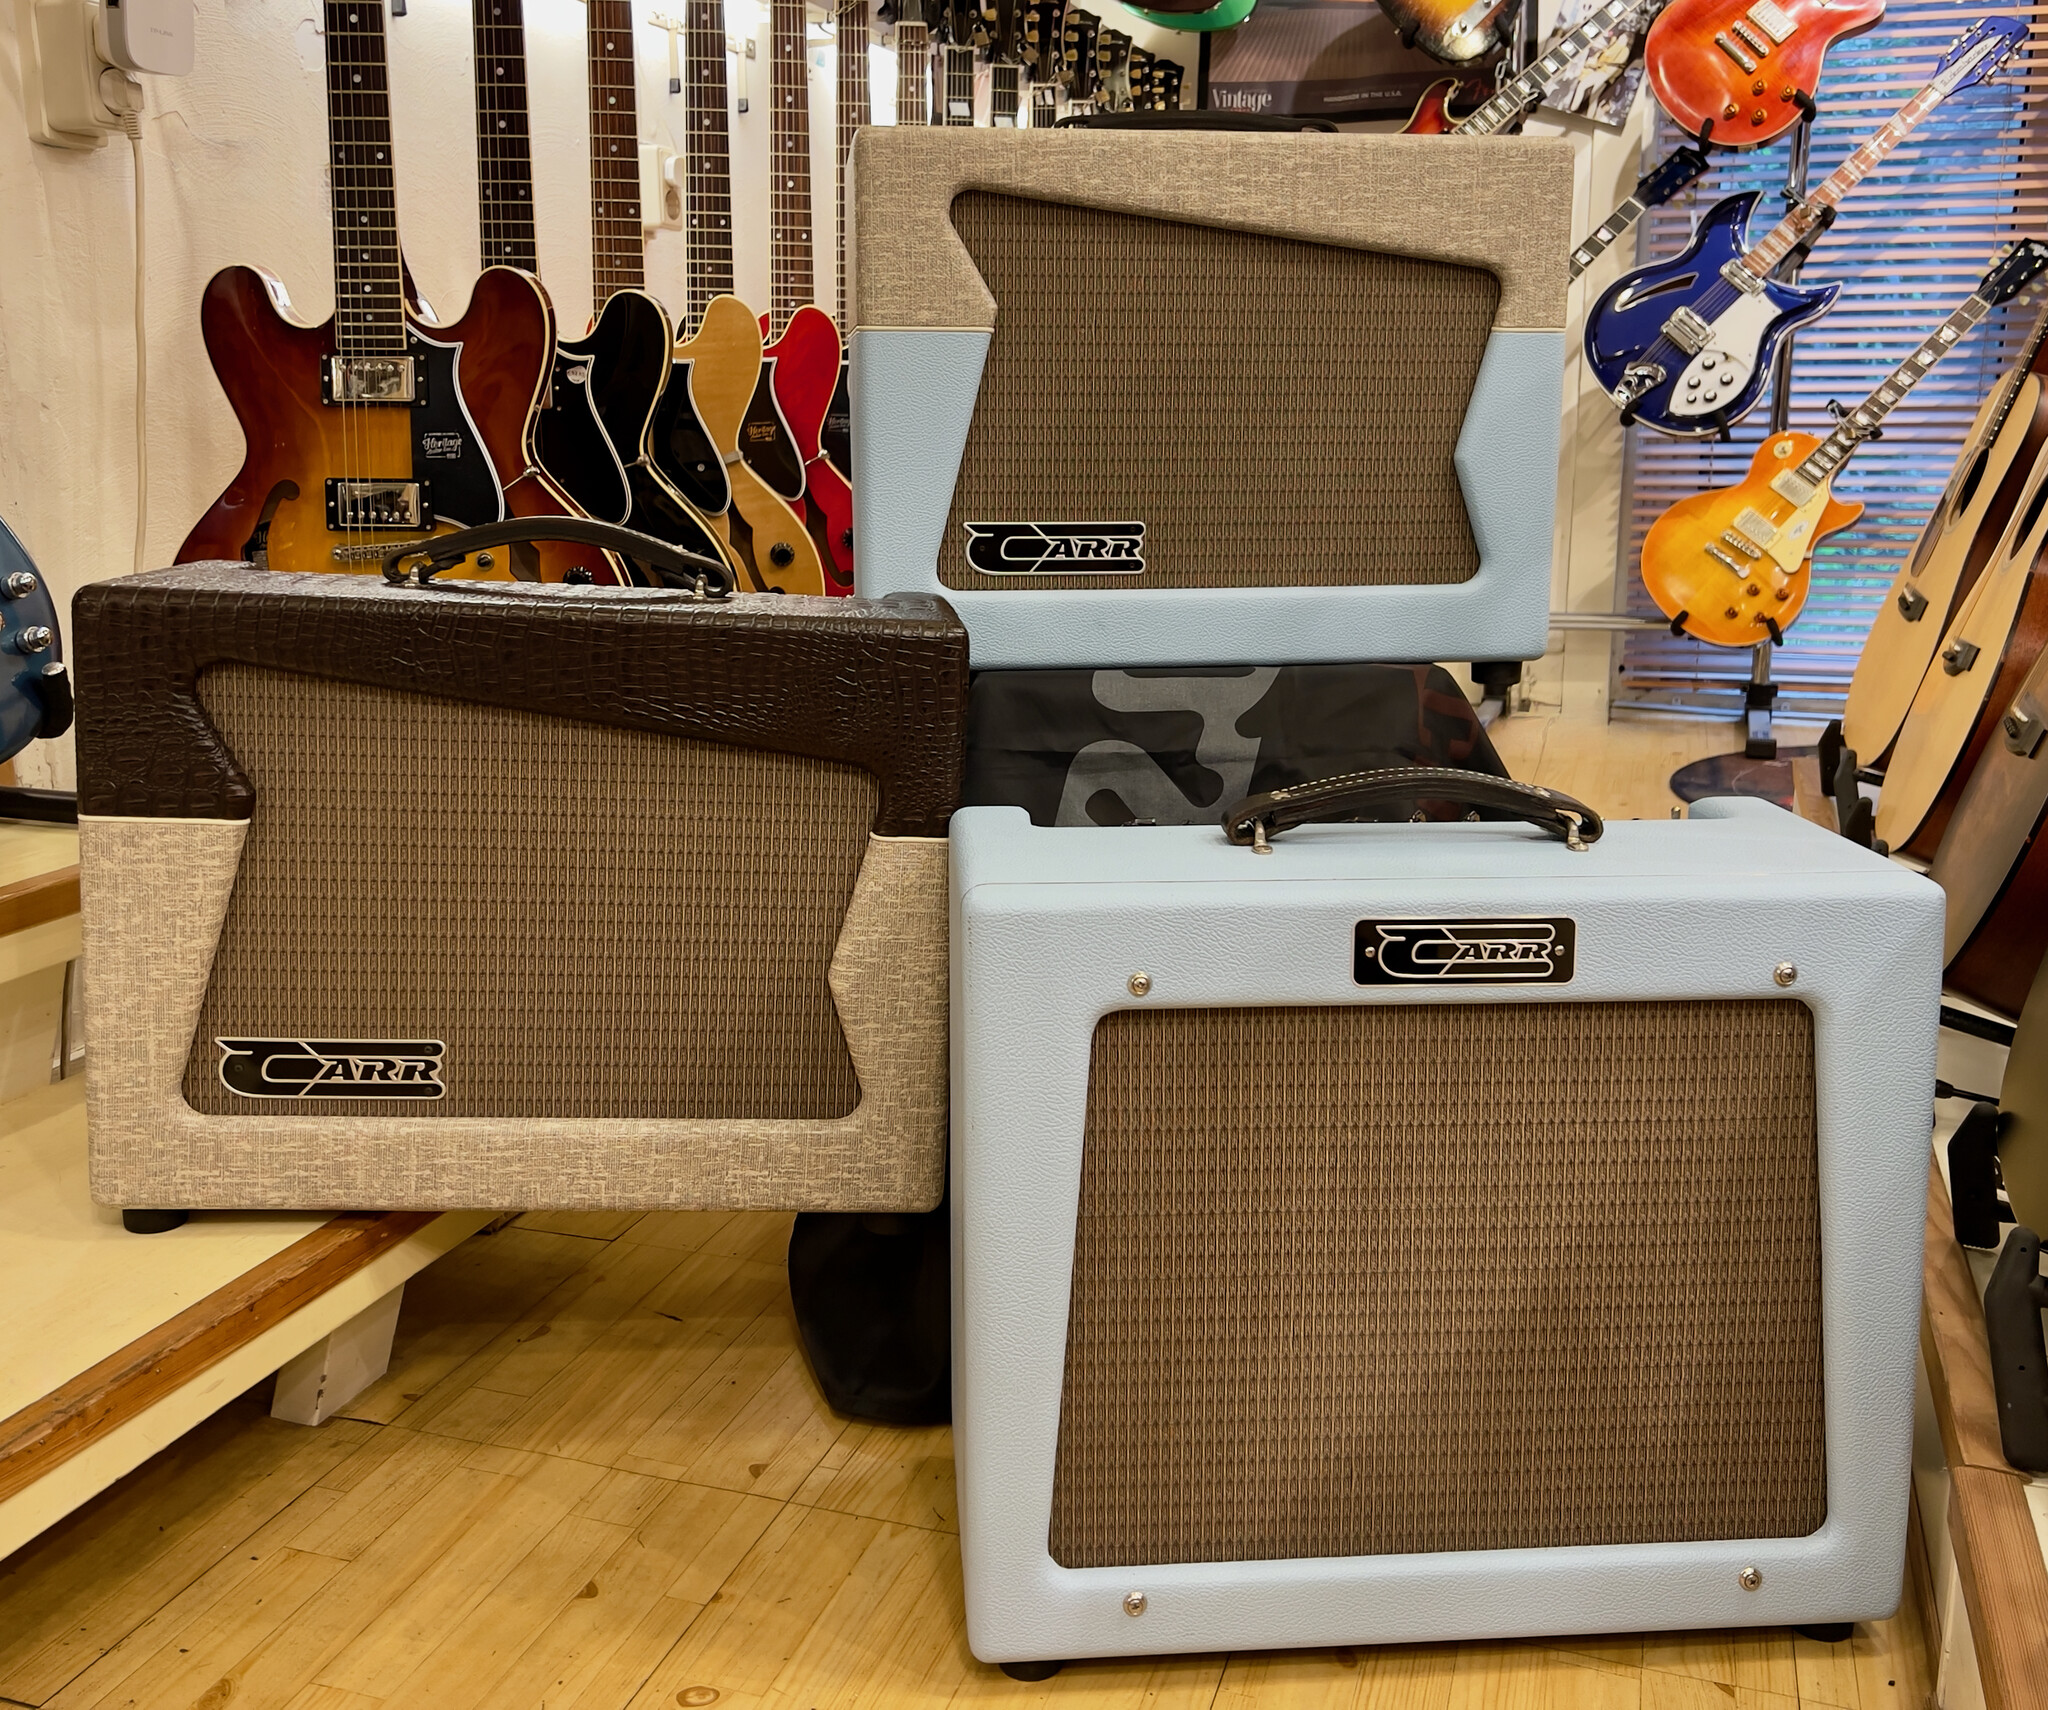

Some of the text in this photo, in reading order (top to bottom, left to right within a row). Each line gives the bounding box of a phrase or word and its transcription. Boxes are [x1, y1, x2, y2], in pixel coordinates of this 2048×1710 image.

[1212, 88, 1272, 113] Vintage
[422, 437, 462, 451] Heritage
[963, 521, 1146, 576] CARR
[1376, 924, 1556, 979] CARR
[214, 1036, 446, 1099] CARR
